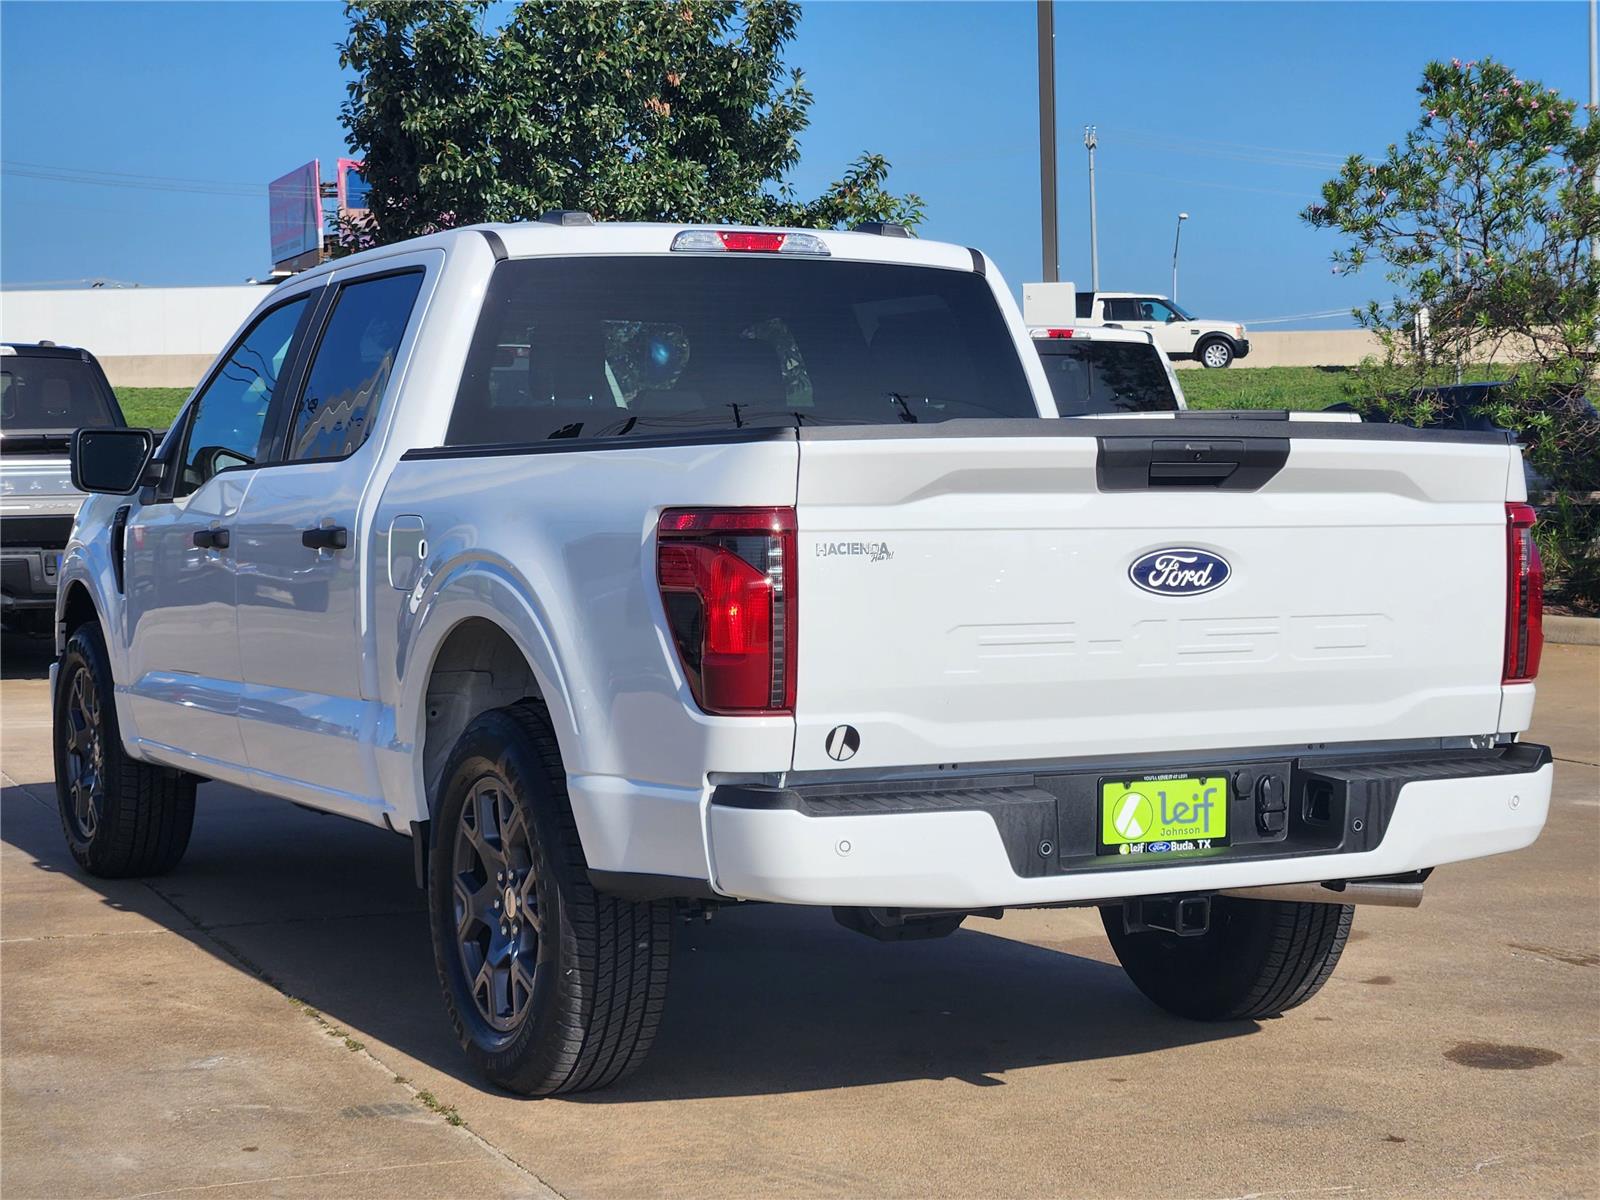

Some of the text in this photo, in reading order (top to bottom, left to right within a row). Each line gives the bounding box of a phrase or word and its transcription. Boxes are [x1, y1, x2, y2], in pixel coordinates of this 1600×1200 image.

[816, 542, 889, 556] HACIENDA
[1148, 554, 1214, 587] Ford
[1157, 788, 1217, 832] leif
[1160, 827, 1201, 837] Johnson
[1130, 842, 1145, 854] leif
[1197, 839, 1211, 849] TX
